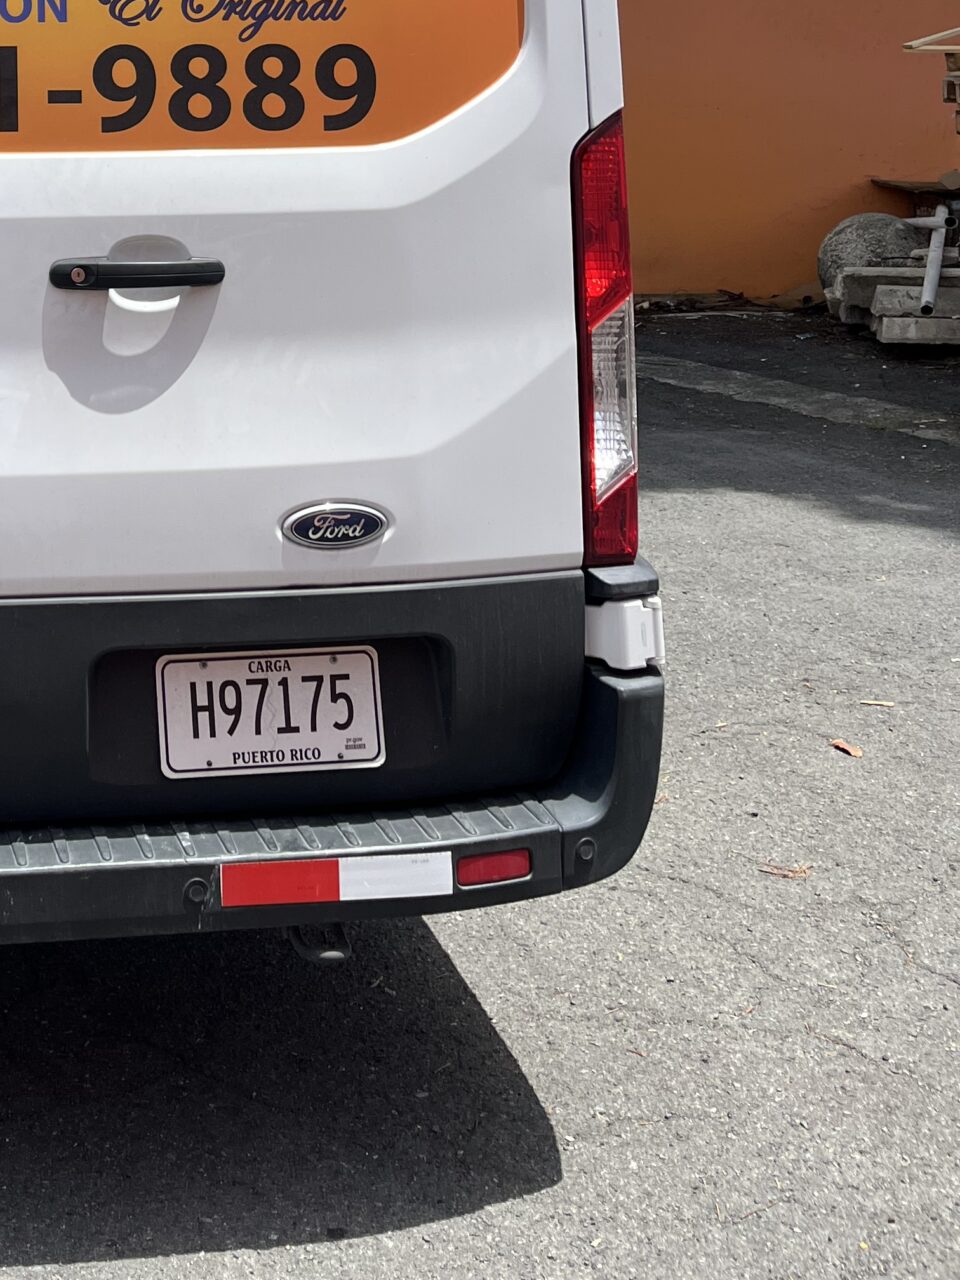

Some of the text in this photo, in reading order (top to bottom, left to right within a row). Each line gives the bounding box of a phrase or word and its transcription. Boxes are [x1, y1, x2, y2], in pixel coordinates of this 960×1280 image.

[308, 513, 366, 540] Ford
[247, 659, 292, 675] CARGA
[189, 673, 355, 740] H97175
[232, 747, 322, 765] PUERTO RICO
